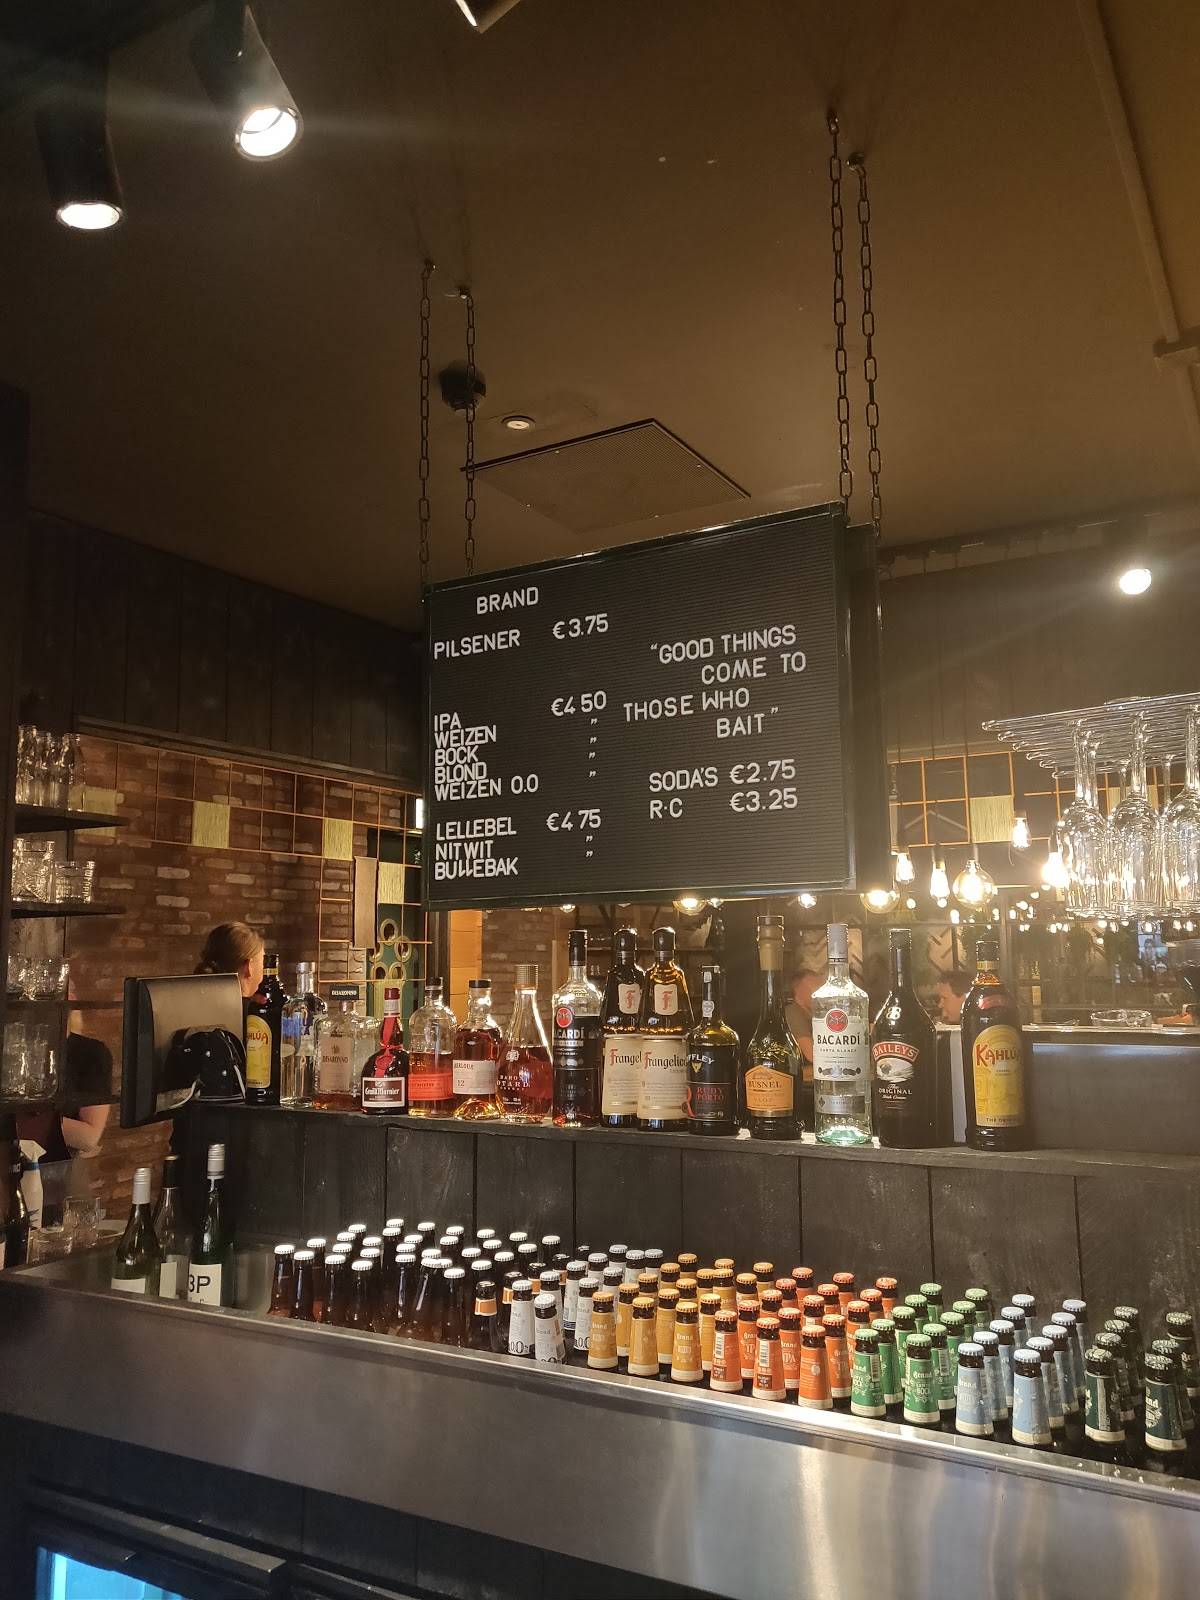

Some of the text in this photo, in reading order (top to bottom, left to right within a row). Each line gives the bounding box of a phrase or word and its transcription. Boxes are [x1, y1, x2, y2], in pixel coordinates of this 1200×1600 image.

[476, 586, 539, 615] BRAND
[552, 613, 609, 640] €3.75
[434, 629, 521, 660] PILSENER
[720, 624, 797, 655] THINGS
[701, 651, 807, 685] COME TO
[623, 687, 750, 722] THOSE WHO
[434, 711, 462, 732] IPA
[434, 724, 497, 749] WEIZEN
[434, 745, 479, 767] BOCK
[434, 762, 487, 785] BLOND
[729, 758, 796, 785] €2.75
[434, 774, 539, 802] WEIZEN 0.0
[729, 788, 798, 813] €3.25
[436, 816, 517, 841] LELLEBEL
[434, 856, 519, 881] BULLEBAK
[817, 1032, 860, 1045] BACARDÍ
[874, 1043, 915, 1057] BAILEYS
